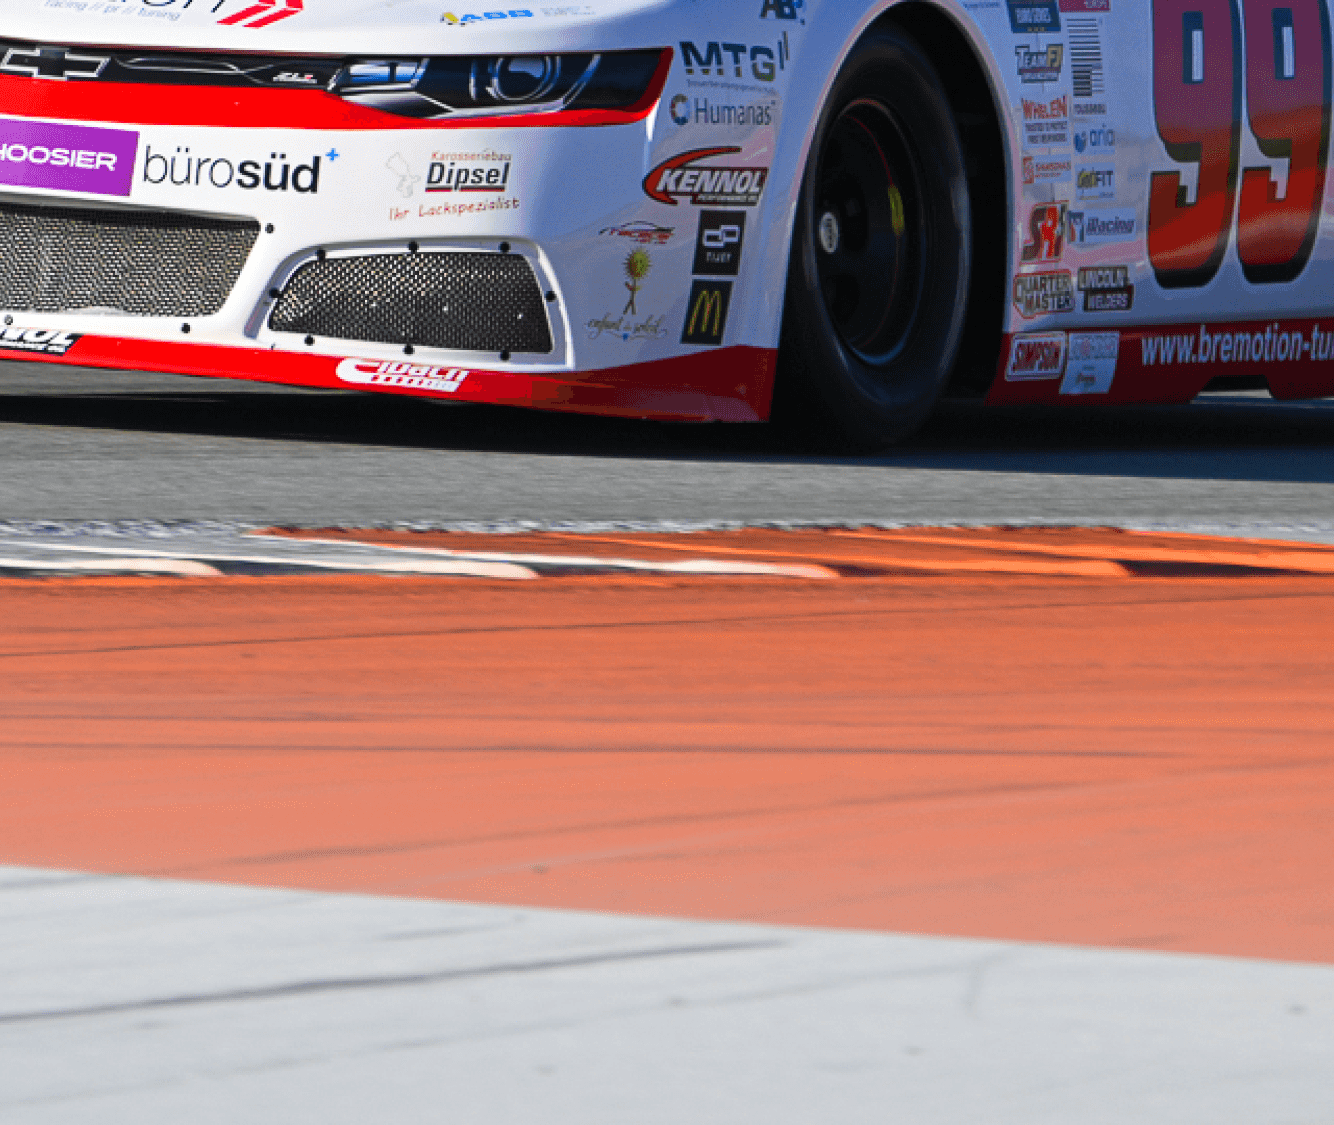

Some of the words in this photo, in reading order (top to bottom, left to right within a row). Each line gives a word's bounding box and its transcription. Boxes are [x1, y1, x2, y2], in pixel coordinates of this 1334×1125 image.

[679, 40, 777, 82] MTG
[1021, 94, 1068, 120] WHELEN
[426, 162, 511, 191] Dipsel
[656, 169, 766, 194] KENNOL
[389, 207, 410, 221] Ihr
[419, 196, 521, 218] Lackspezialist
[1086, 215, 1135, 236] iRacing
